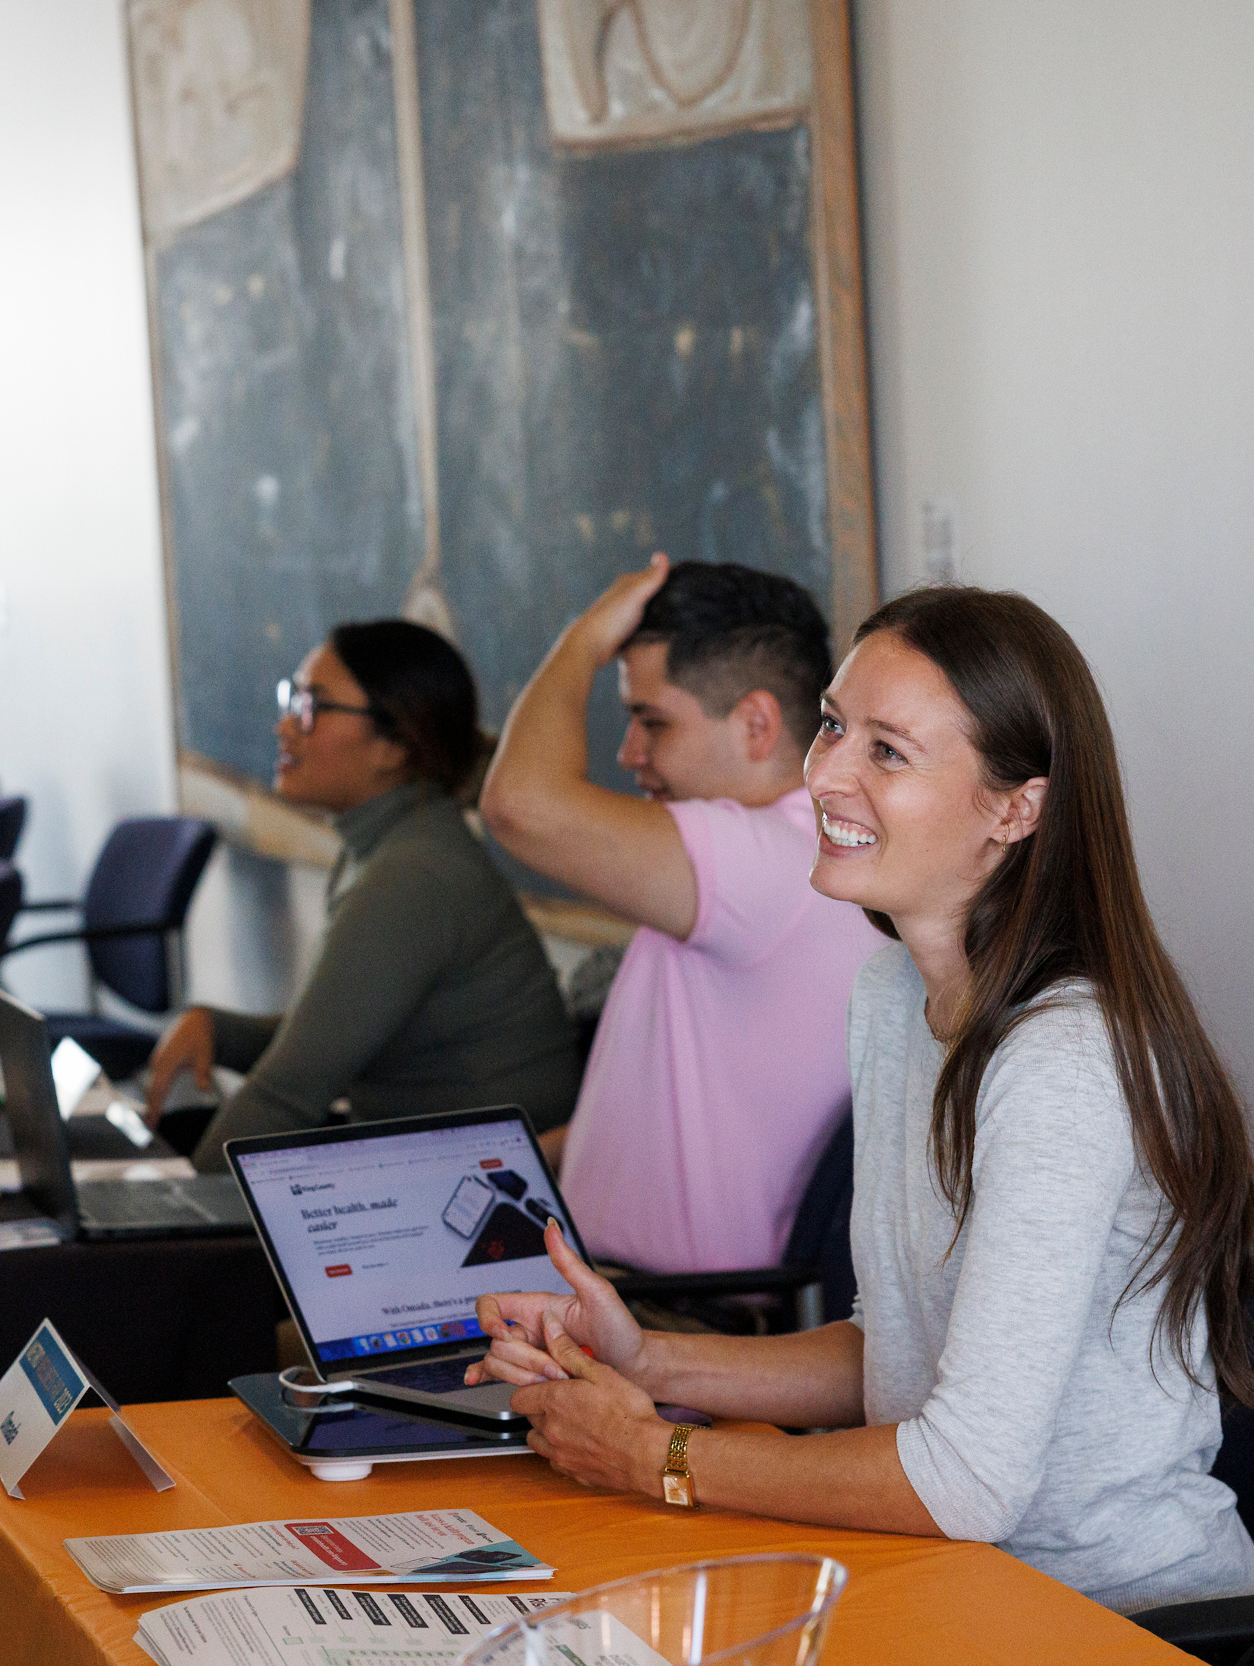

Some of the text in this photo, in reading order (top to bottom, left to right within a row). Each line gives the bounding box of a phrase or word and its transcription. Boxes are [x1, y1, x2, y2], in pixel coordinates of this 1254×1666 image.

[301, 1208, 332, 1220] Better
[369, 1197, 398, 1210] made
[307, 1221, 338, 1233] easier
